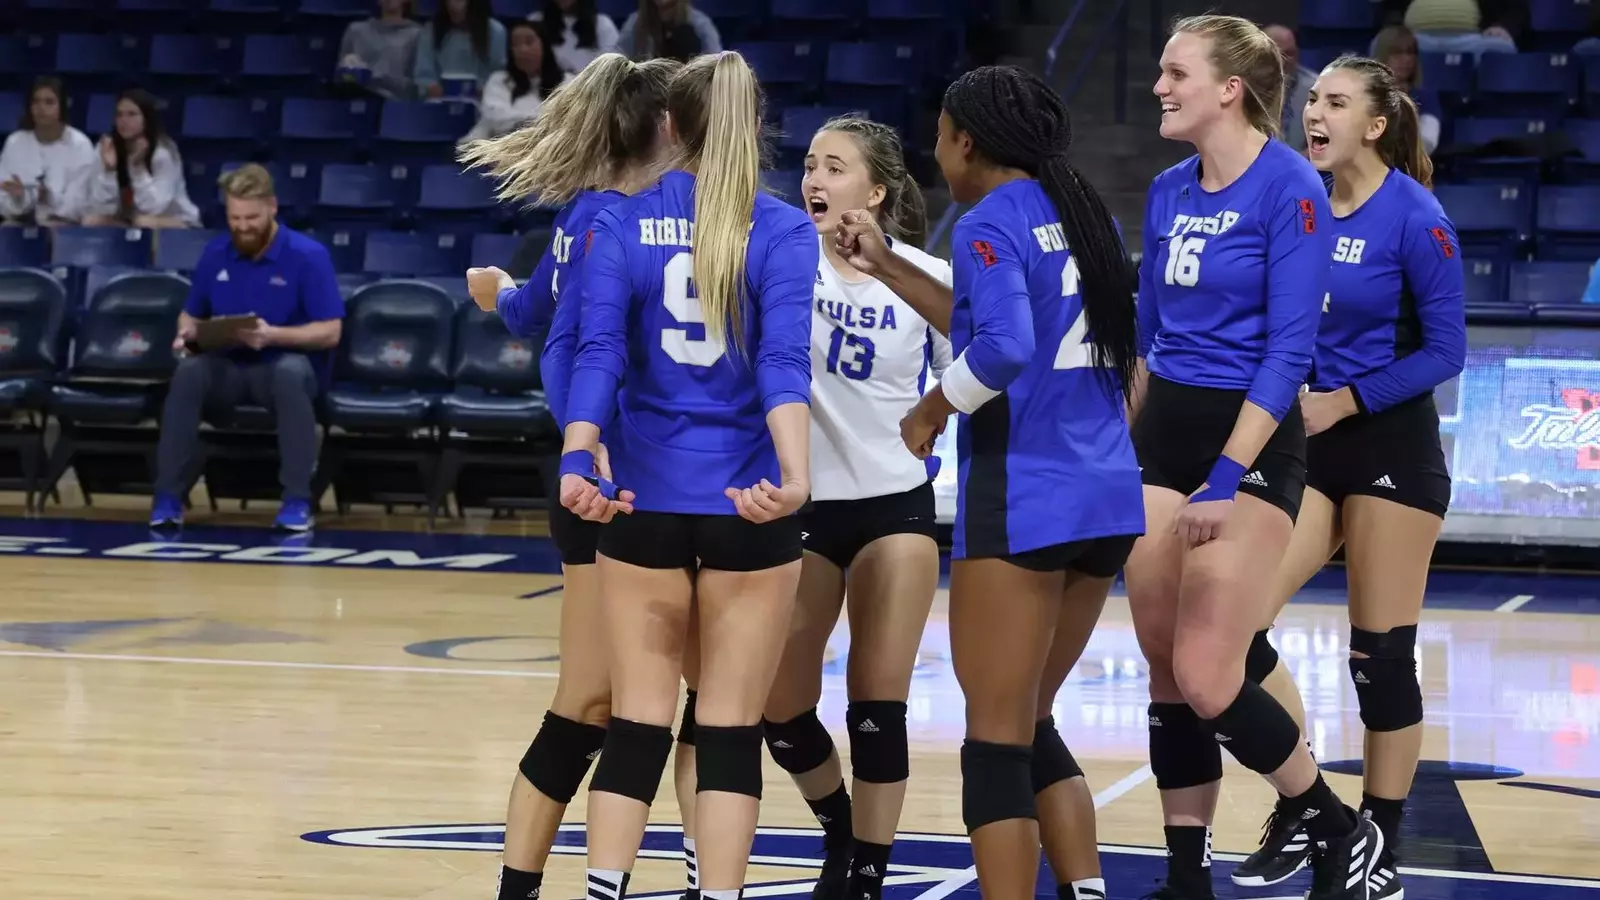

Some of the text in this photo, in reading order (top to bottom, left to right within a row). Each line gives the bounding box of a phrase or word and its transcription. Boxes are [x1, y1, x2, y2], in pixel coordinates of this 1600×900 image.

[1165, 235, 1206, 287] 16
[661, 252, 726, 367] 9
[815, 298, 897, 329] TULSA
[1053, 255, 1118, 370] 2
[827, 326, 876, 381] 13
